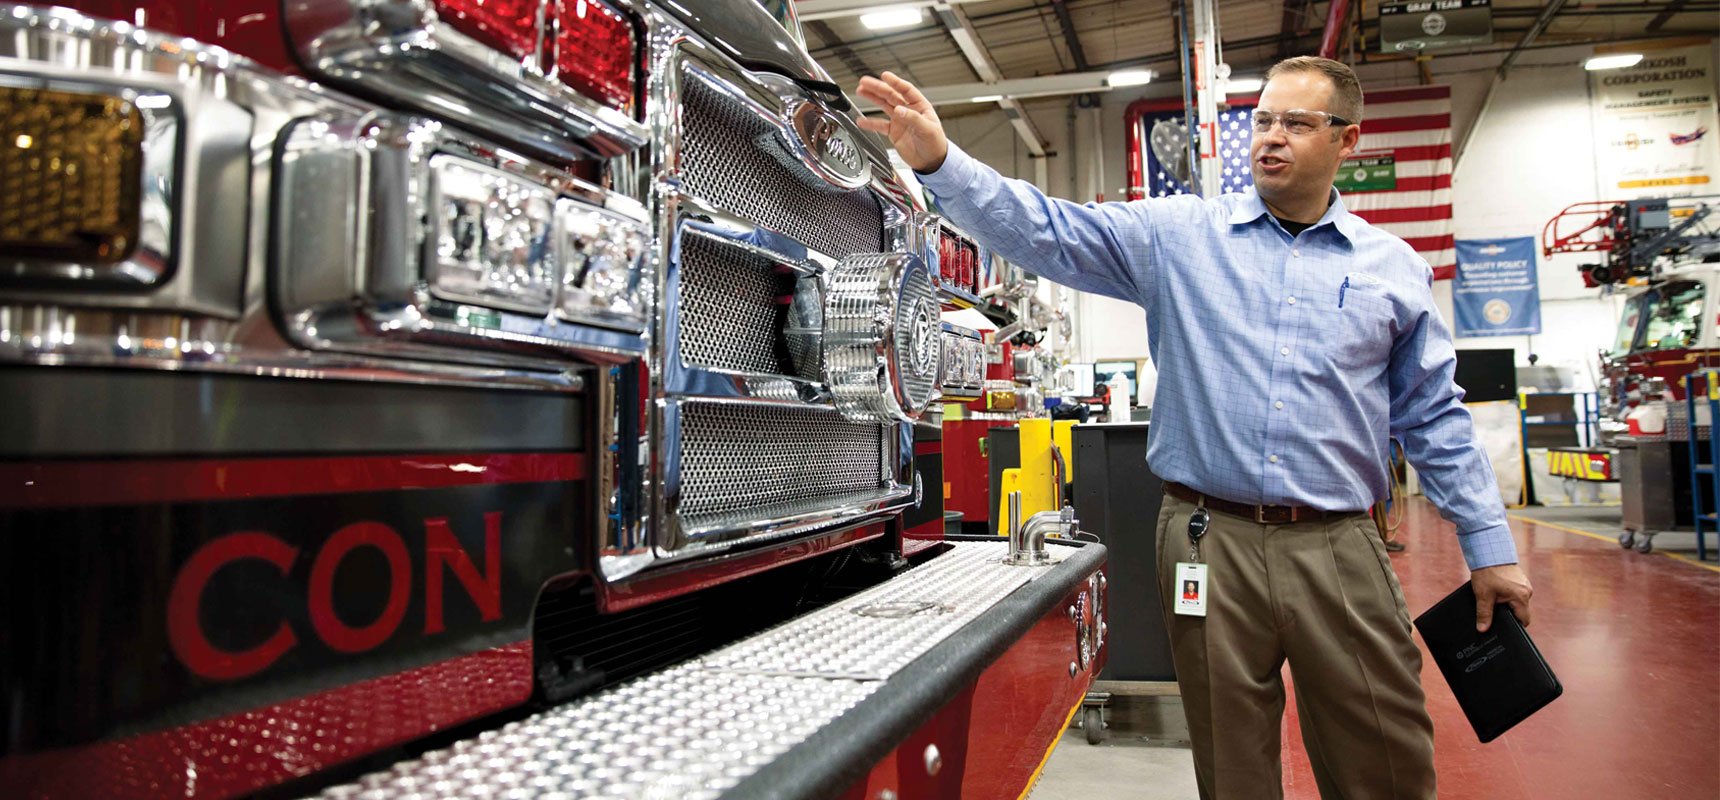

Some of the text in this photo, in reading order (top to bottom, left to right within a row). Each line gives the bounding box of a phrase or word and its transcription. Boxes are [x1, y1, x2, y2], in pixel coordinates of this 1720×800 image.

[1406, 3, 1432, 13] GRAY
[1435, 0, 1462, 10] TEAM
[1603, 68, 1706, 86] CORPORATION
[1638, 89, 1673, 98] SAFETY
[1461, 260, 1528, 271] QUALITY POLICY
[167, 511, 503, 681] CON
